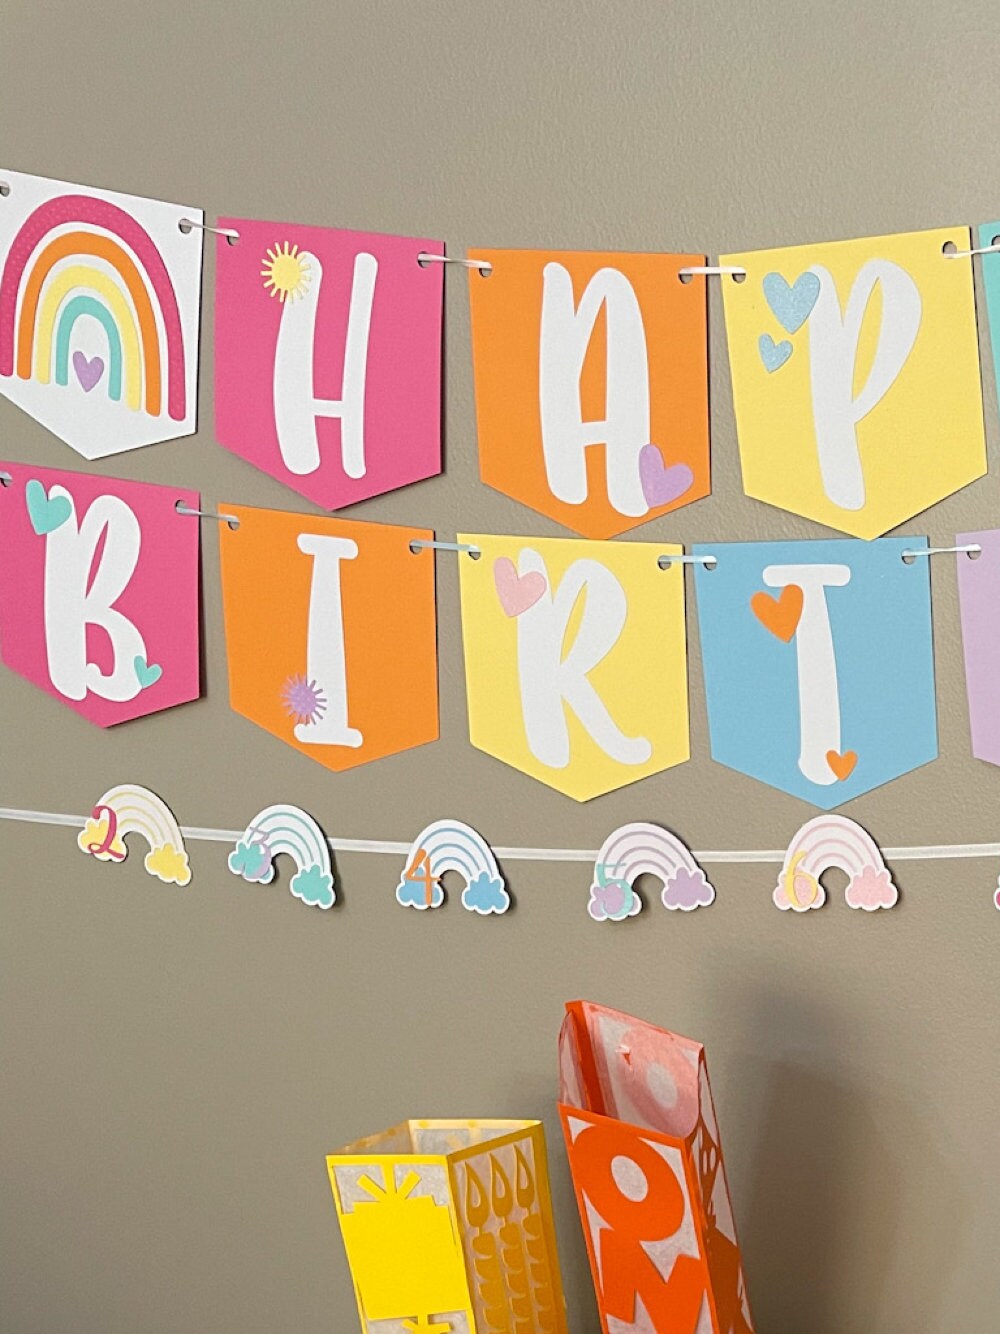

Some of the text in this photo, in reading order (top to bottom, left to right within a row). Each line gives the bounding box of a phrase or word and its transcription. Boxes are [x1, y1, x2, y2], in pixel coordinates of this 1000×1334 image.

[88, 805, 125, 860] 2
[241, 827, 271, 879] 3
[405, 848, 442, 905] 4
[596, 862, 633, 918] 5
[786, 850, 818, 907] 6
